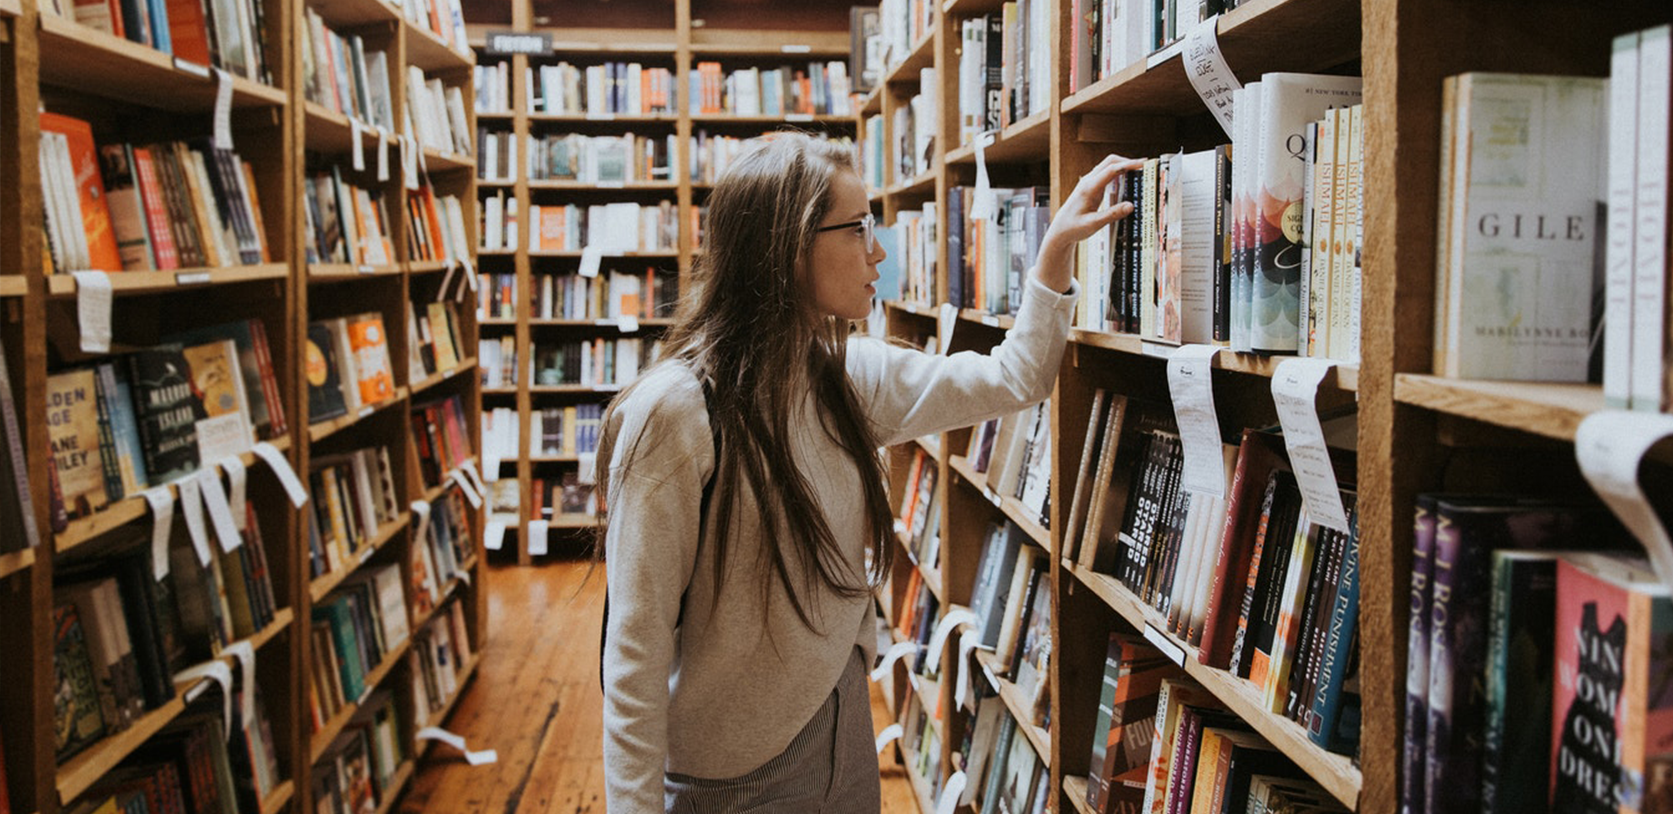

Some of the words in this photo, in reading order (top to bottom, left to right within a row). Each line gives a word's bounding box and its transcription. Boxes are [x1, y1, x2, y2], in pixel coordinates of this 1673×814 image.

[1319, 162, 1332, 228] ISHMAEL
[1334, 164, 1346, 231] ISHMAEL
[1347, 161, 1358, 230] ISHMAEL
[1478, 213, 1585, 242] GILE
[1126, 495, 1146, 559] OTARD
[1133, 498, 1152, 563] OTARED
[1138, 501, 1158, 567] OTARED
[1328, 534, 1338, 555] WHY
[1336, 538, 1346, 558] WHY
[1323, 561, 1333, 583] CAME
[1330, 564, 1340, 587] CAME
[1296, 606, 1313, 665] CROCODILES
[1314, 593, 1348, 707] PUNISHMENT
